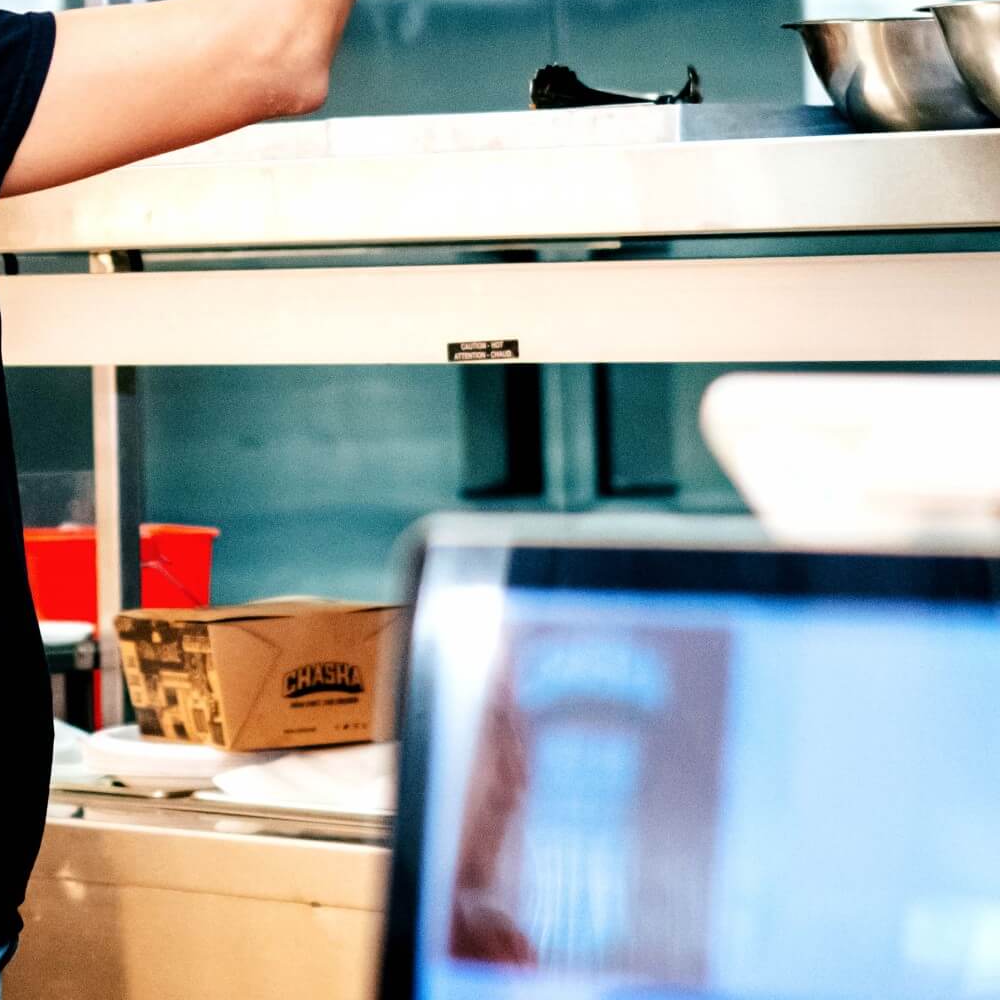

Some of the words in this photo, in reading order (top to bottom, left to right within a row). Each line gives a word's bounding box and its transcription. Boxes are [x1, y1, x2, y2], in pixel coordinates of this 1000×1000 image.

[460, 342, 487, 351] CAUTION
[490, 340, 504, 349] HOT
[454, 351, 486, 361] ATTENTION
[282, 662, 365, 698] CHASKA
